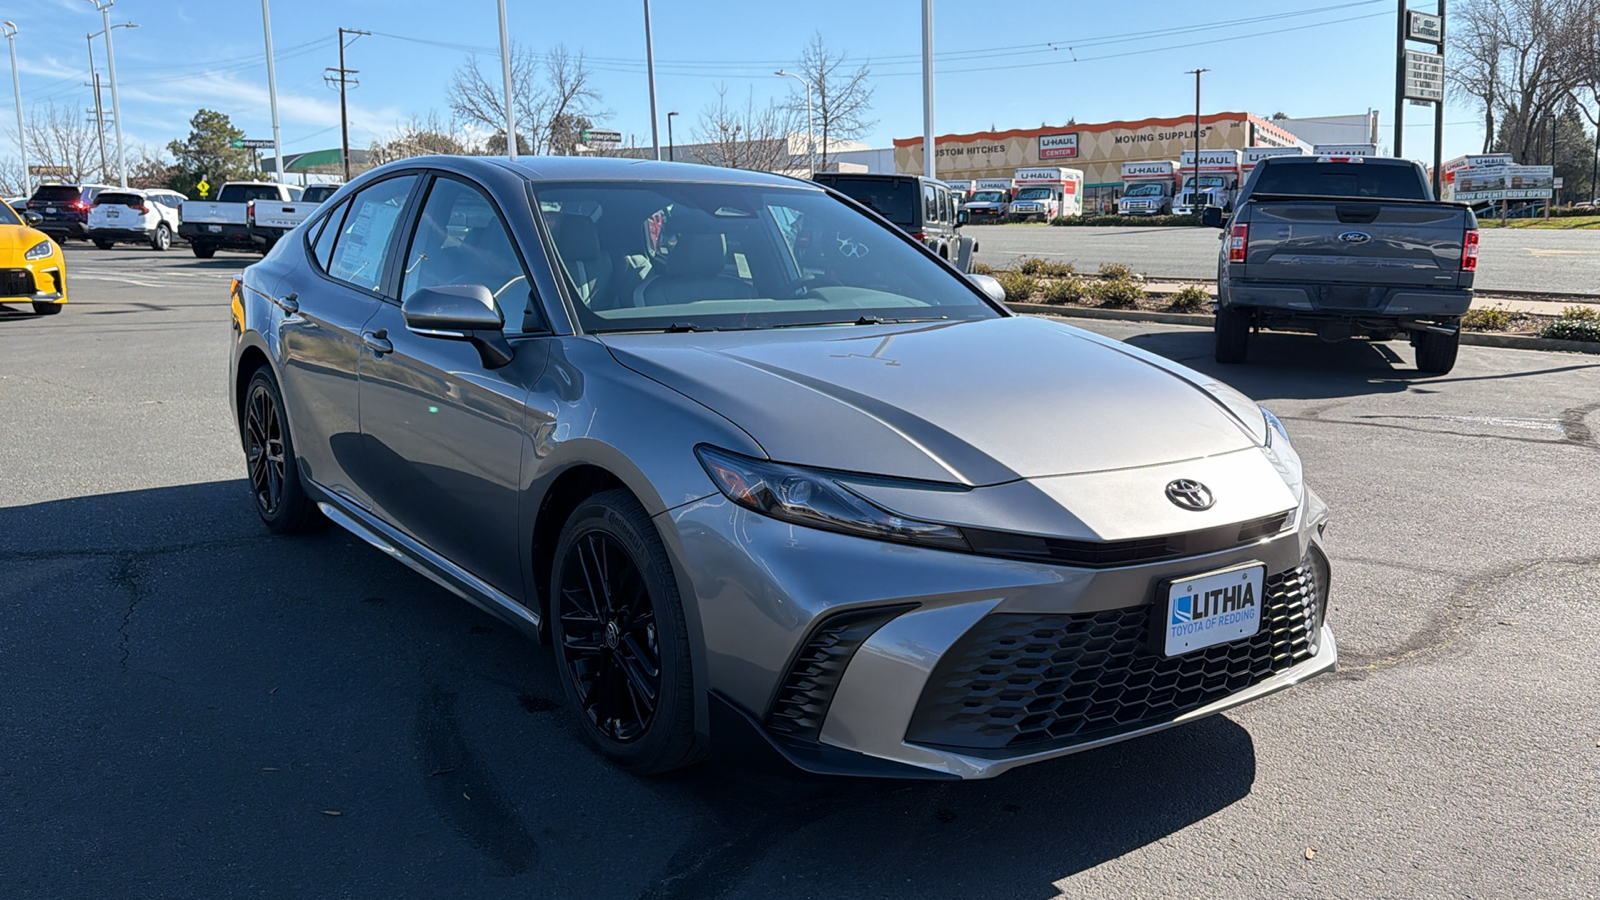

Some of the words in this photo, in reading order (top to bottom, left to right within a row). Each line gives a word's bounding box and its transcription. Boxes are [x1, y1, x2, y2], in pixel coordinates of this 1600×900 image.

[1042, 138, 1075, 147] U-HAUL
[1115, 133, 1154, 144] MOVING
[934, 148, 964, 158] USTOM
[967, 144, 1006, 155] HITCHES
[1046, 149, 1072, 157] CENTER
[1456, 192, 1475, 200] NOW
[1477, 191, 1502, 199] OPEN!
[1528, 189, 1550, 197] OPEN!
[608, 512, 642, 550] Continental
[1192, 582, 1255, 621] LITHIA
[1171, 621, 1204, 638] TOYOTA
[1205, 617, 1217, 630] OF
[1218, 608, 1255, 627] REDDING
